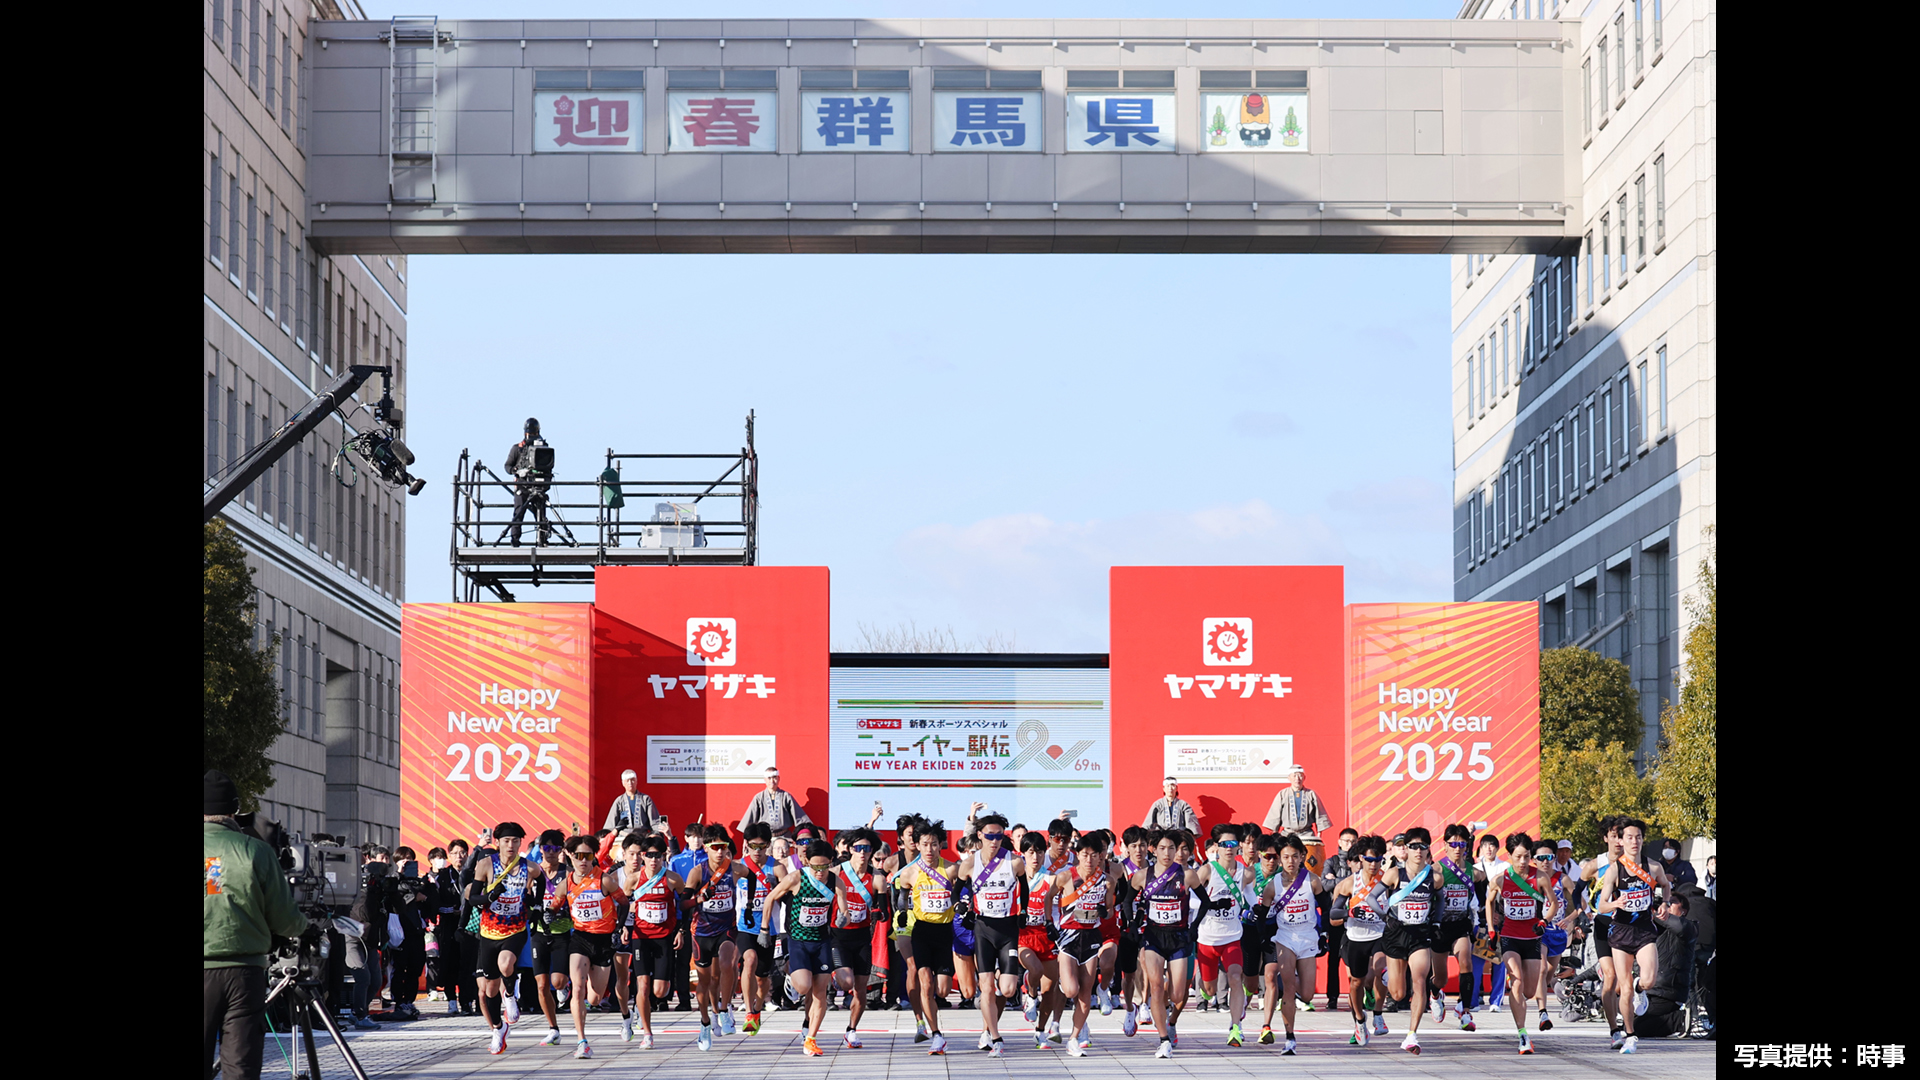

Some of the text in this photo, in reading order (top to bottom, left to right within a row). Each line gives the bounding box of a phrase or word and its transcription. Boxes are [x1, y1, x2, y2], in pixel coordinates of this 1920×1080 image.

[648, 673, 776, 699] ヤマザキ
[1164, 673, 1292, 698] ヤマザキ
[480, 683, 561, 711] Happy
[1378, 682, 1459, 710] Happy
[448, 711, 561, 733] New Year
[868, 719, 900, 728] ヤマザキ
[909, 719, 1008, 729] 新春スポーツスペシャル
[1378, 711, 1491, 732] New Year
[855, 734, 1011, 757] ニューイヤー駅伝
[445, 742, 562, 783] 2025
[659, 755, 730, 766] ニューイヤー駅伝
[855, 760, 997, 770] NEW YEAR EKIDEN 2025
[1177, 755, 1247, 766] ニューイヤー駅伝
[1378, 742, 1495, 782] 2025
[496, 903, 517, 912] 35-1
[709, 900, 730, 909] 29-1
[927, 900, 949, 908] 33-1
[987, 900, 1006, 909] 8-1
[1447, 898, 1465, 907] 16-1
[1626, 898, 1648, 908] 20-1
[577, 909, 598, 918] 28-1
[646, 910, 664, 919] 4-1
[1157, 911, 1178, 920] 13-1
[1215, 909, 1234, 917] 36-1
[1509, 907, 1532, 917] 24-1
[1288, 914, 1307, 922] 2-1
